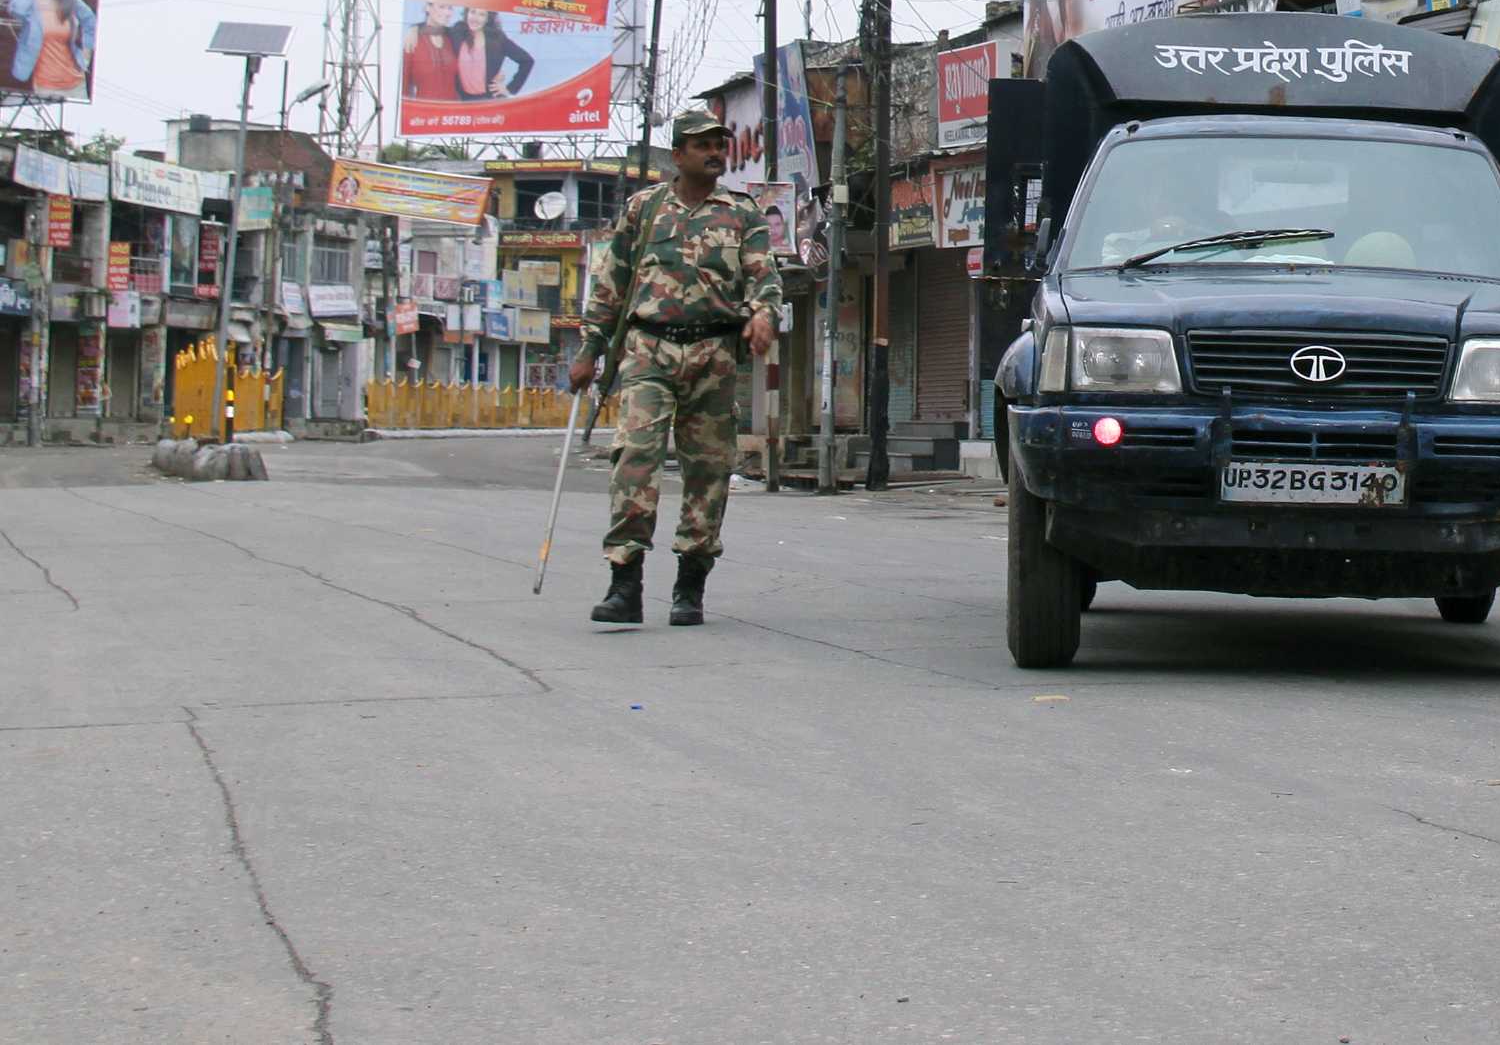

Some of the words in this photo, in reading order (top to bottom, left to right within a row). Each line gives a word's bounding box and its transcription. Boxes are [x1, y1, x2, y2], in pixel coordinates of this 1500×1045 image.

[1154, 43, 1230, 76] उत्तर
[1232, 40, 1311, 82] प्रदेश
[1314, 38, 1413, 83] पुलिस
[569, 111, 600, 123] airtel
